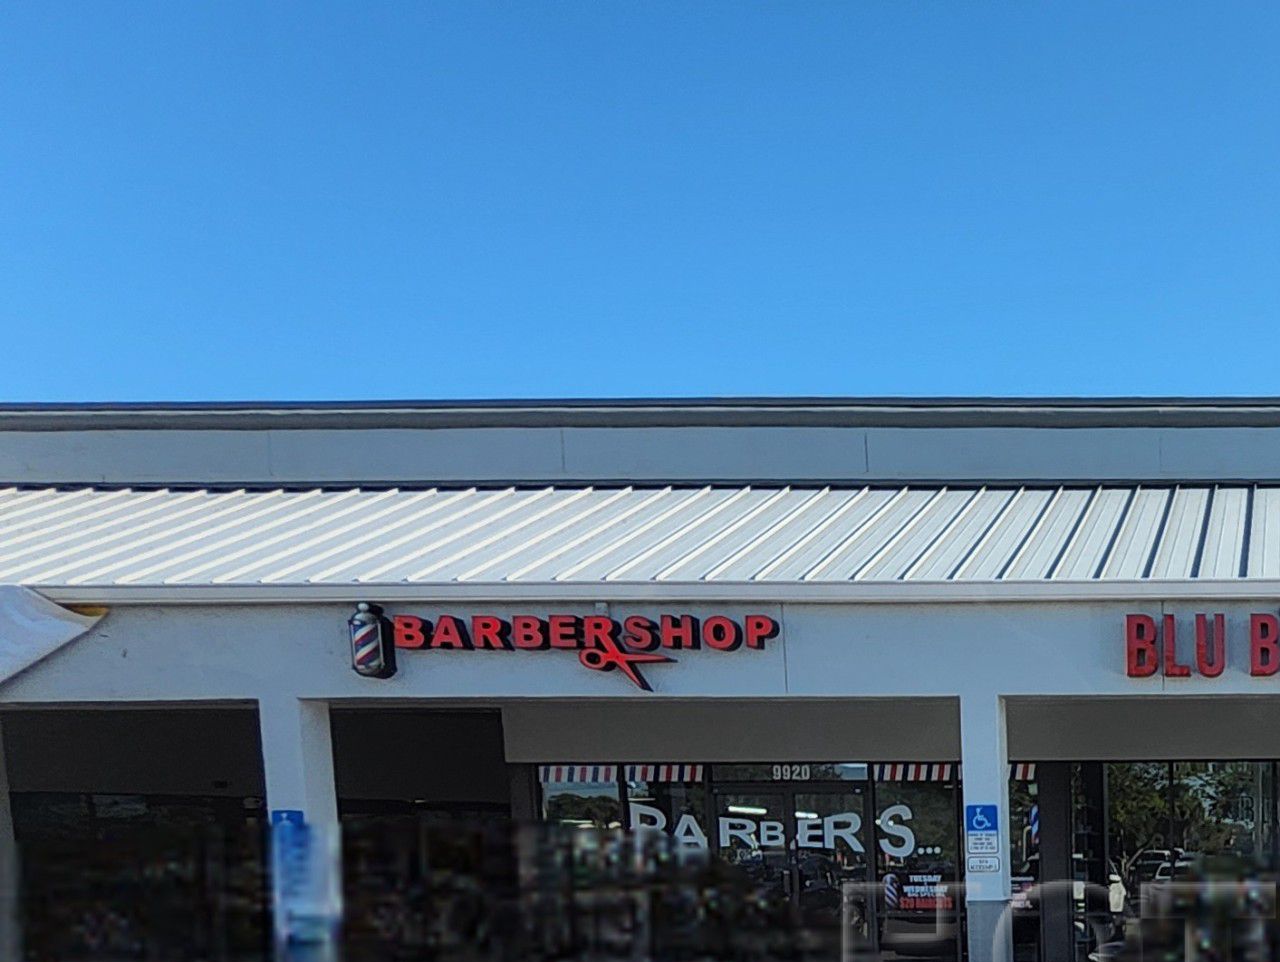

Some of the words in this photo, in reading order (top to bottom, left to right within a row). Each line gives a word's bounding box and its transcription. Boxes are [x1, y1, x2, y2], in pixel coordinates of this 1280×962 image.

[393, 614, 781, 682] BARBERSHOP
[1126, 613, 1225, 677] BLU
[772, 764, 810, 780] 9920
